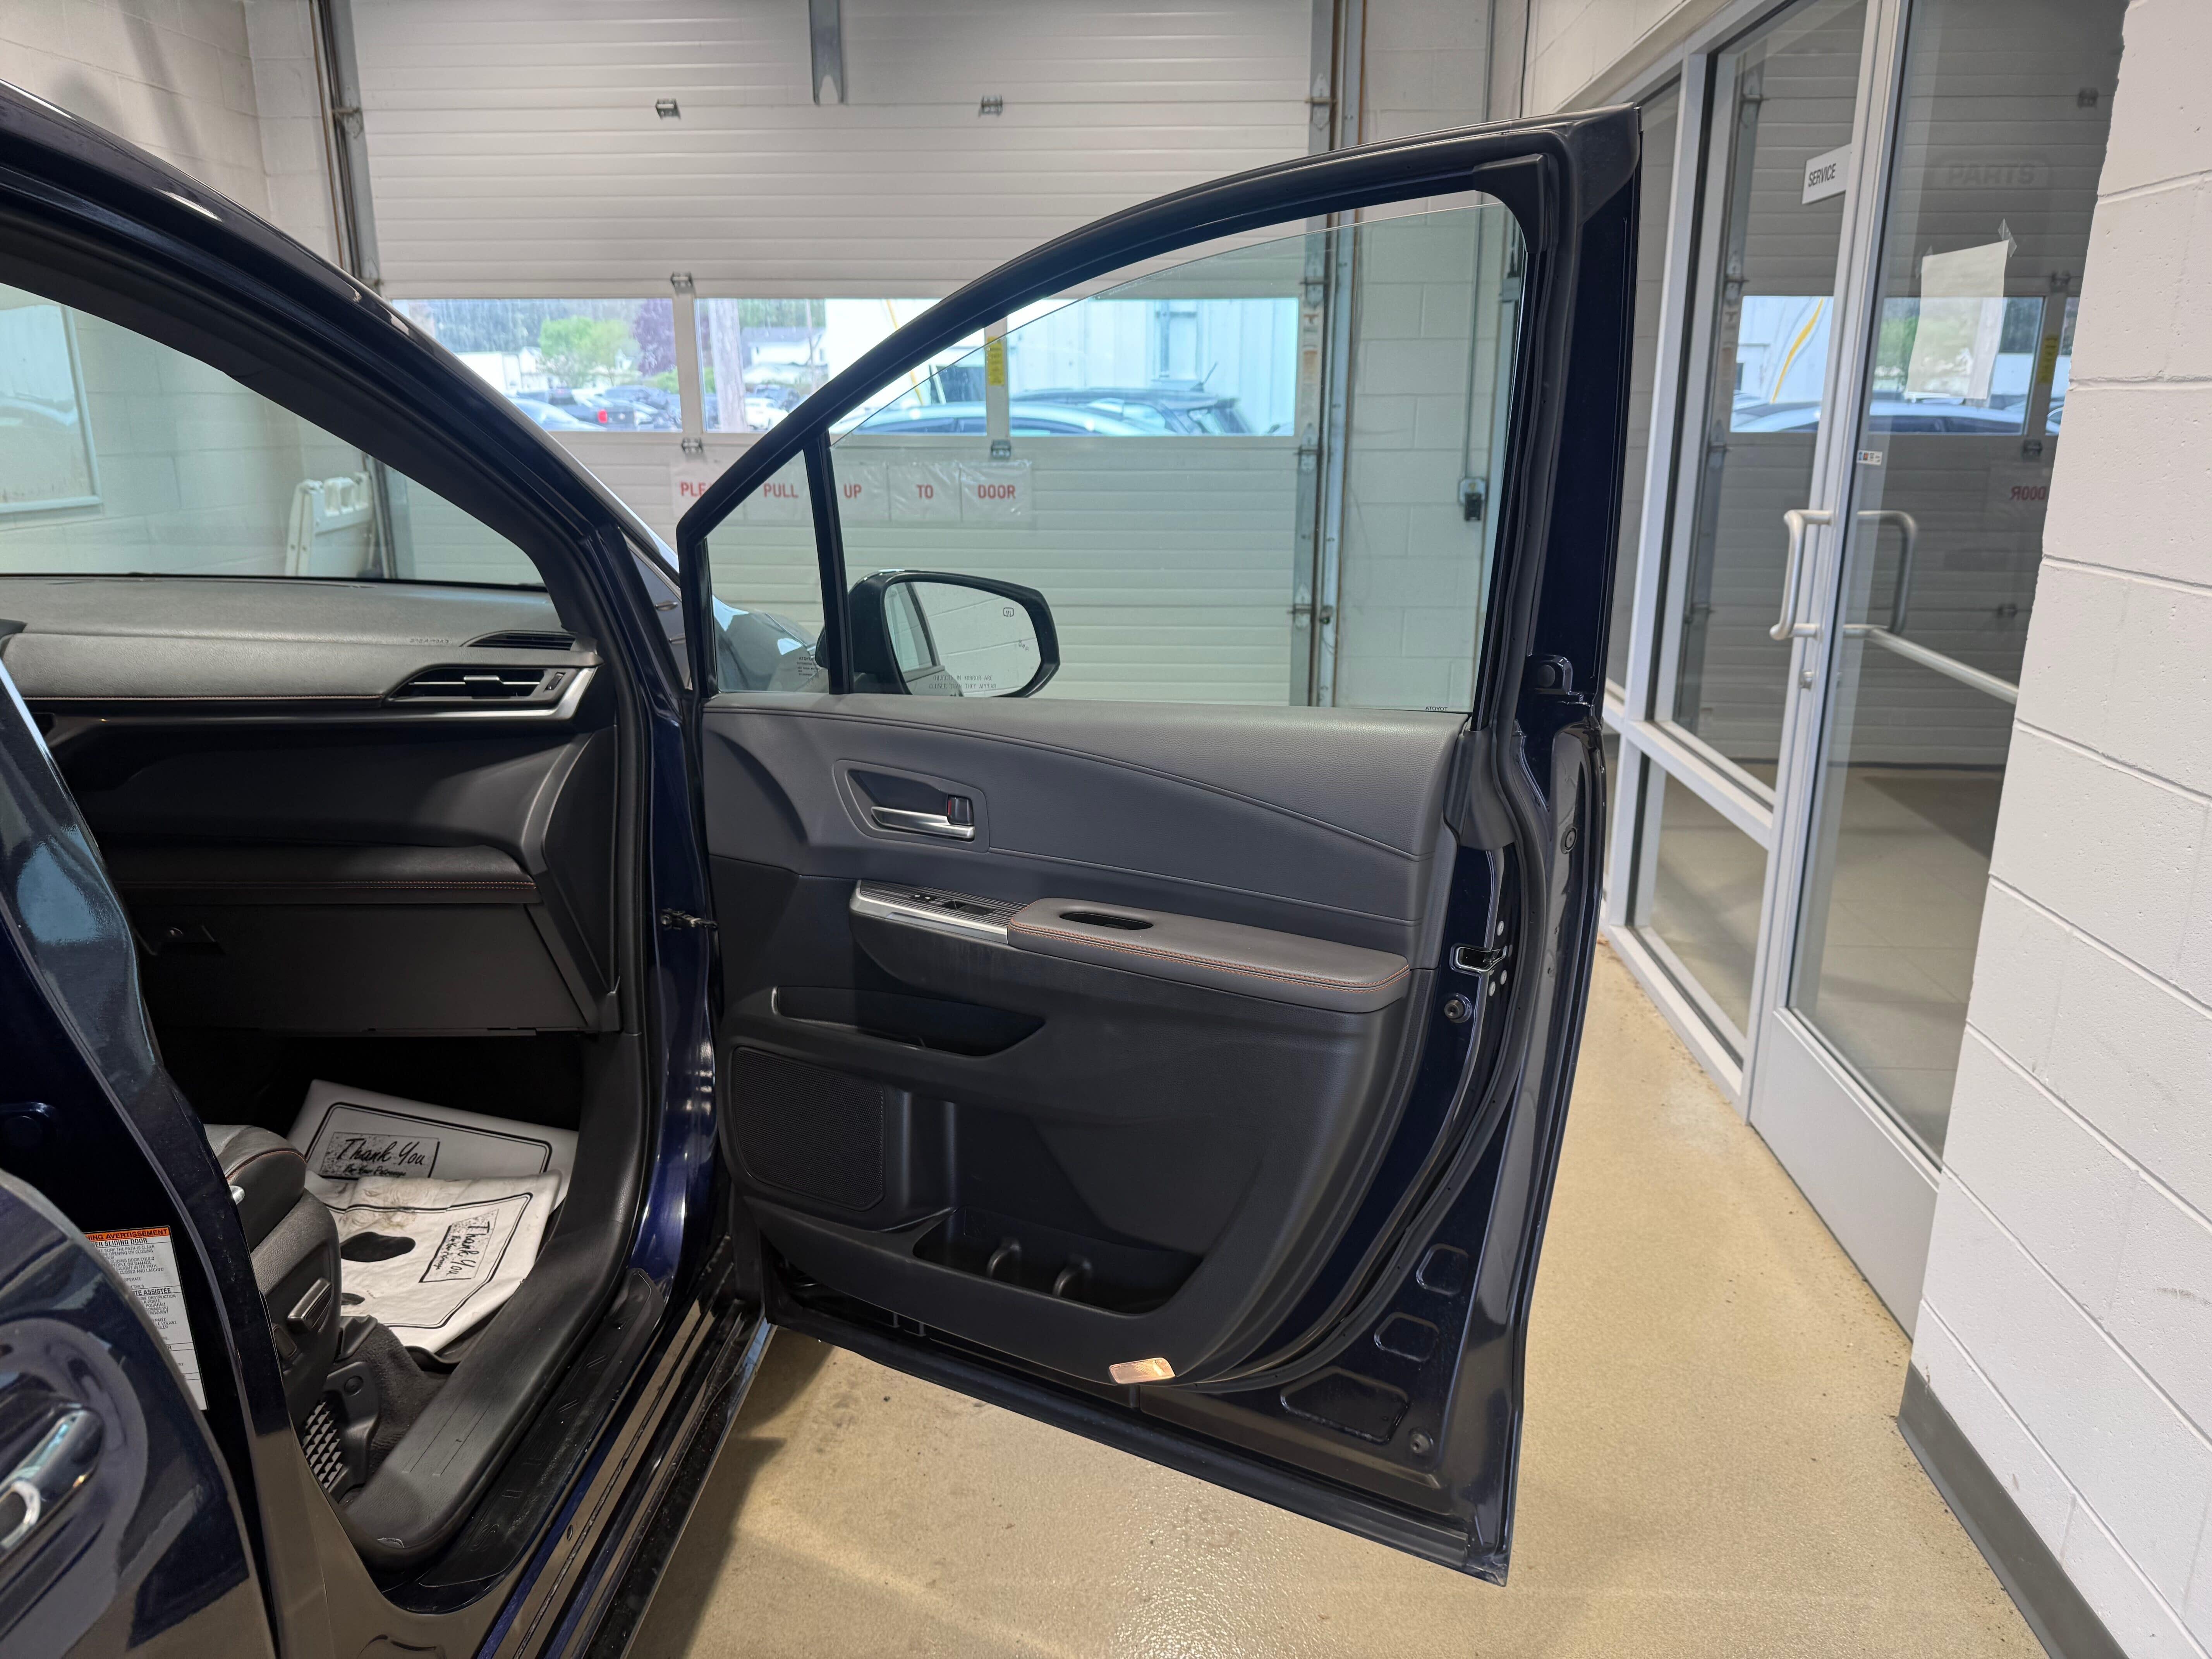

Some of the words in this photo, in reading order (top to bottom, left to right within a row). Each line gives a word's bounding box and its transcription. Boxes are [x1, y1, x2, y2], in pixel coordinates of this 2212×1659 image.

[1808, 163, 1836, 187] SERVICE
[1949, 163, 2035, 184] PARTS
[763, 483, 799, 498] PULL
[843, 484, 862, 498] UP
[916, 484, 934, 499] TO
[977, 484, 1016, 499] DOOR
[337, 1138, 398, 1162] Thank
[398, 1141, 425, 1165] You
[105, 1229, 167, 1239] AVERTISSEMENT
[458, 1221, 490, 1257] Thank
[446, 1259, 477, 1276] You
[144, 1286, 171, 1295] ASSISTÉE
